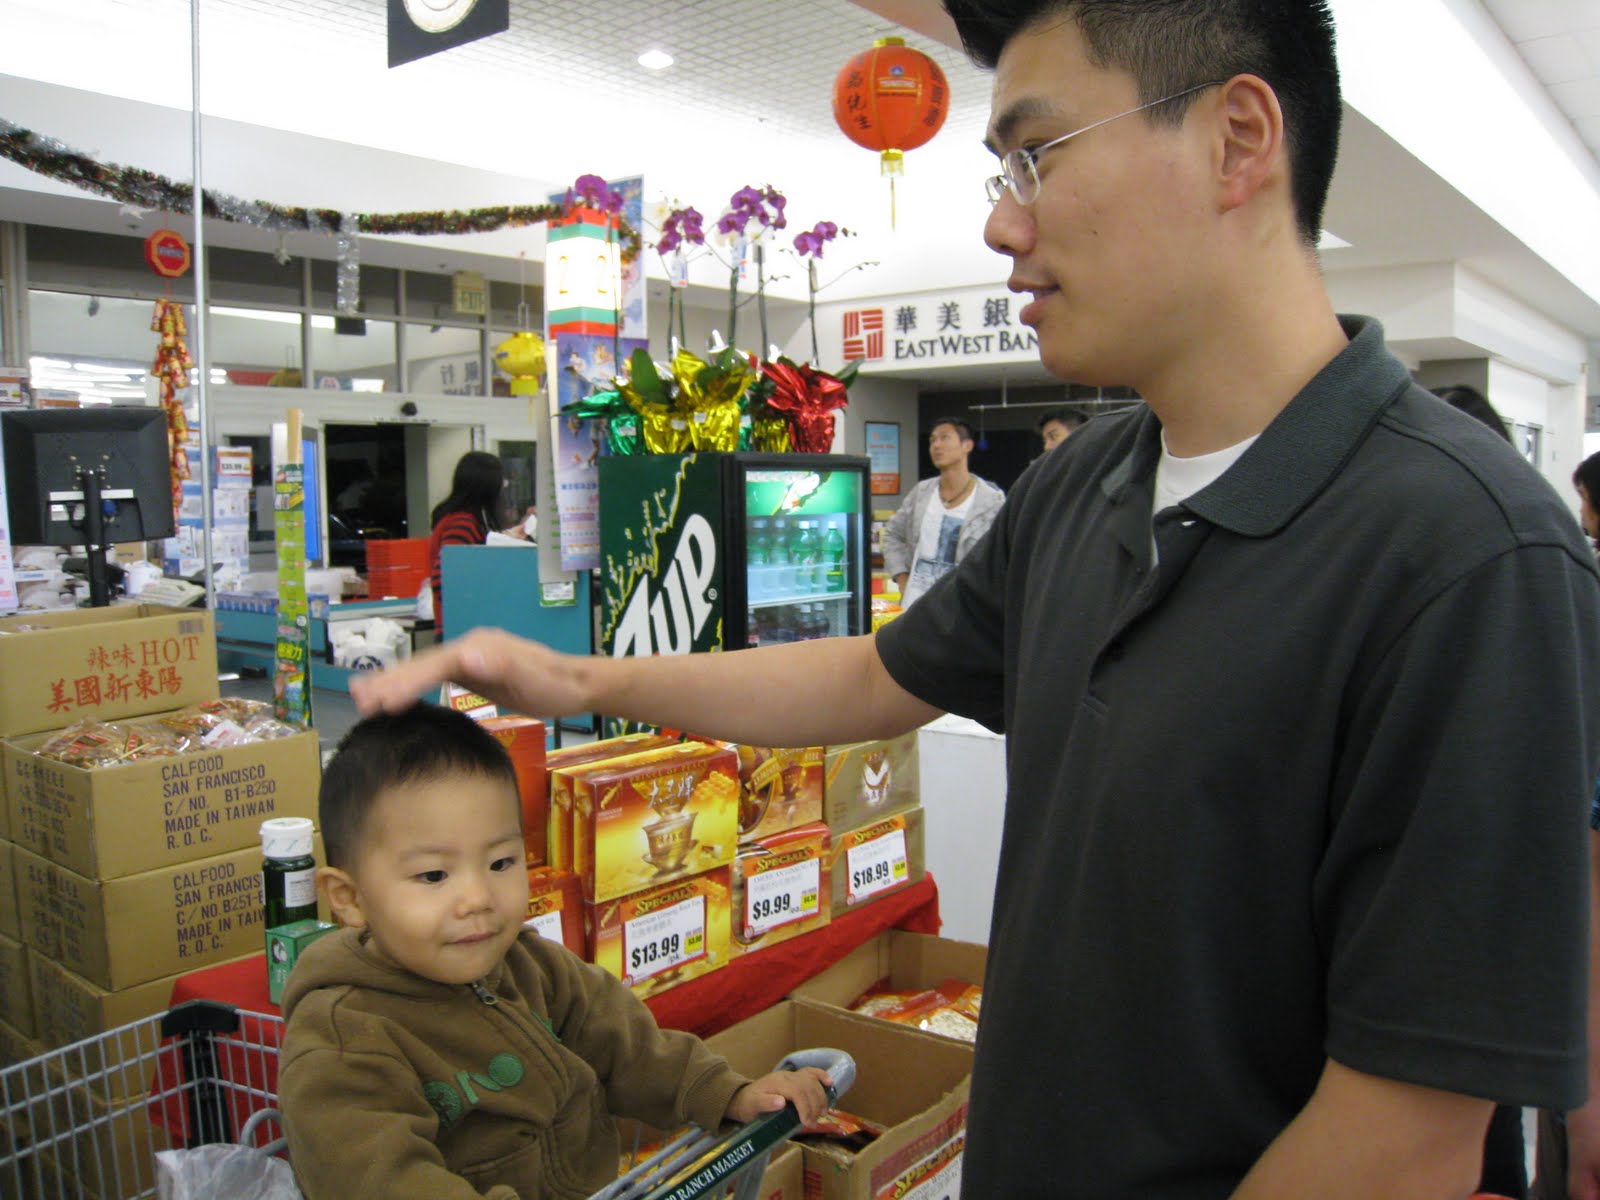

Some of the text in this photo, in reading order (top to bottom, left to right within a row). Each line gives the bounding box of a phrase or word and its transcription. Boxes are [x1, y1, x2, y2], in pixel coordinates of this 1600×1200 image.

[139, 635, 199, 666] HOT
[47, 665, 183, 713] 美國新東陽
[161, 755, 224, 781] CALFOOD
[163, 765, 266, 798] SAN FRANCISCO
[165, 799, 275, 834] MADE IN TAIWAN
[757, 847, 812, 873] SPECIALS
[853, 861, 889, 888] $18.99
[173, 863, 235, 891] CALFOOD
[175, 889, 201, 908] SAN
[635, 883, 694, 916] SPECIALS
[753, 893, 790, 920] $9.99
[177, 921, 213, 942] MADE
[218, 917, 231, 932] IN
[632, 933, 679, 969] $13.99
[676, 1167, 715, 1200] RANCH
[712, 1139, 756, 1176] MARKET
